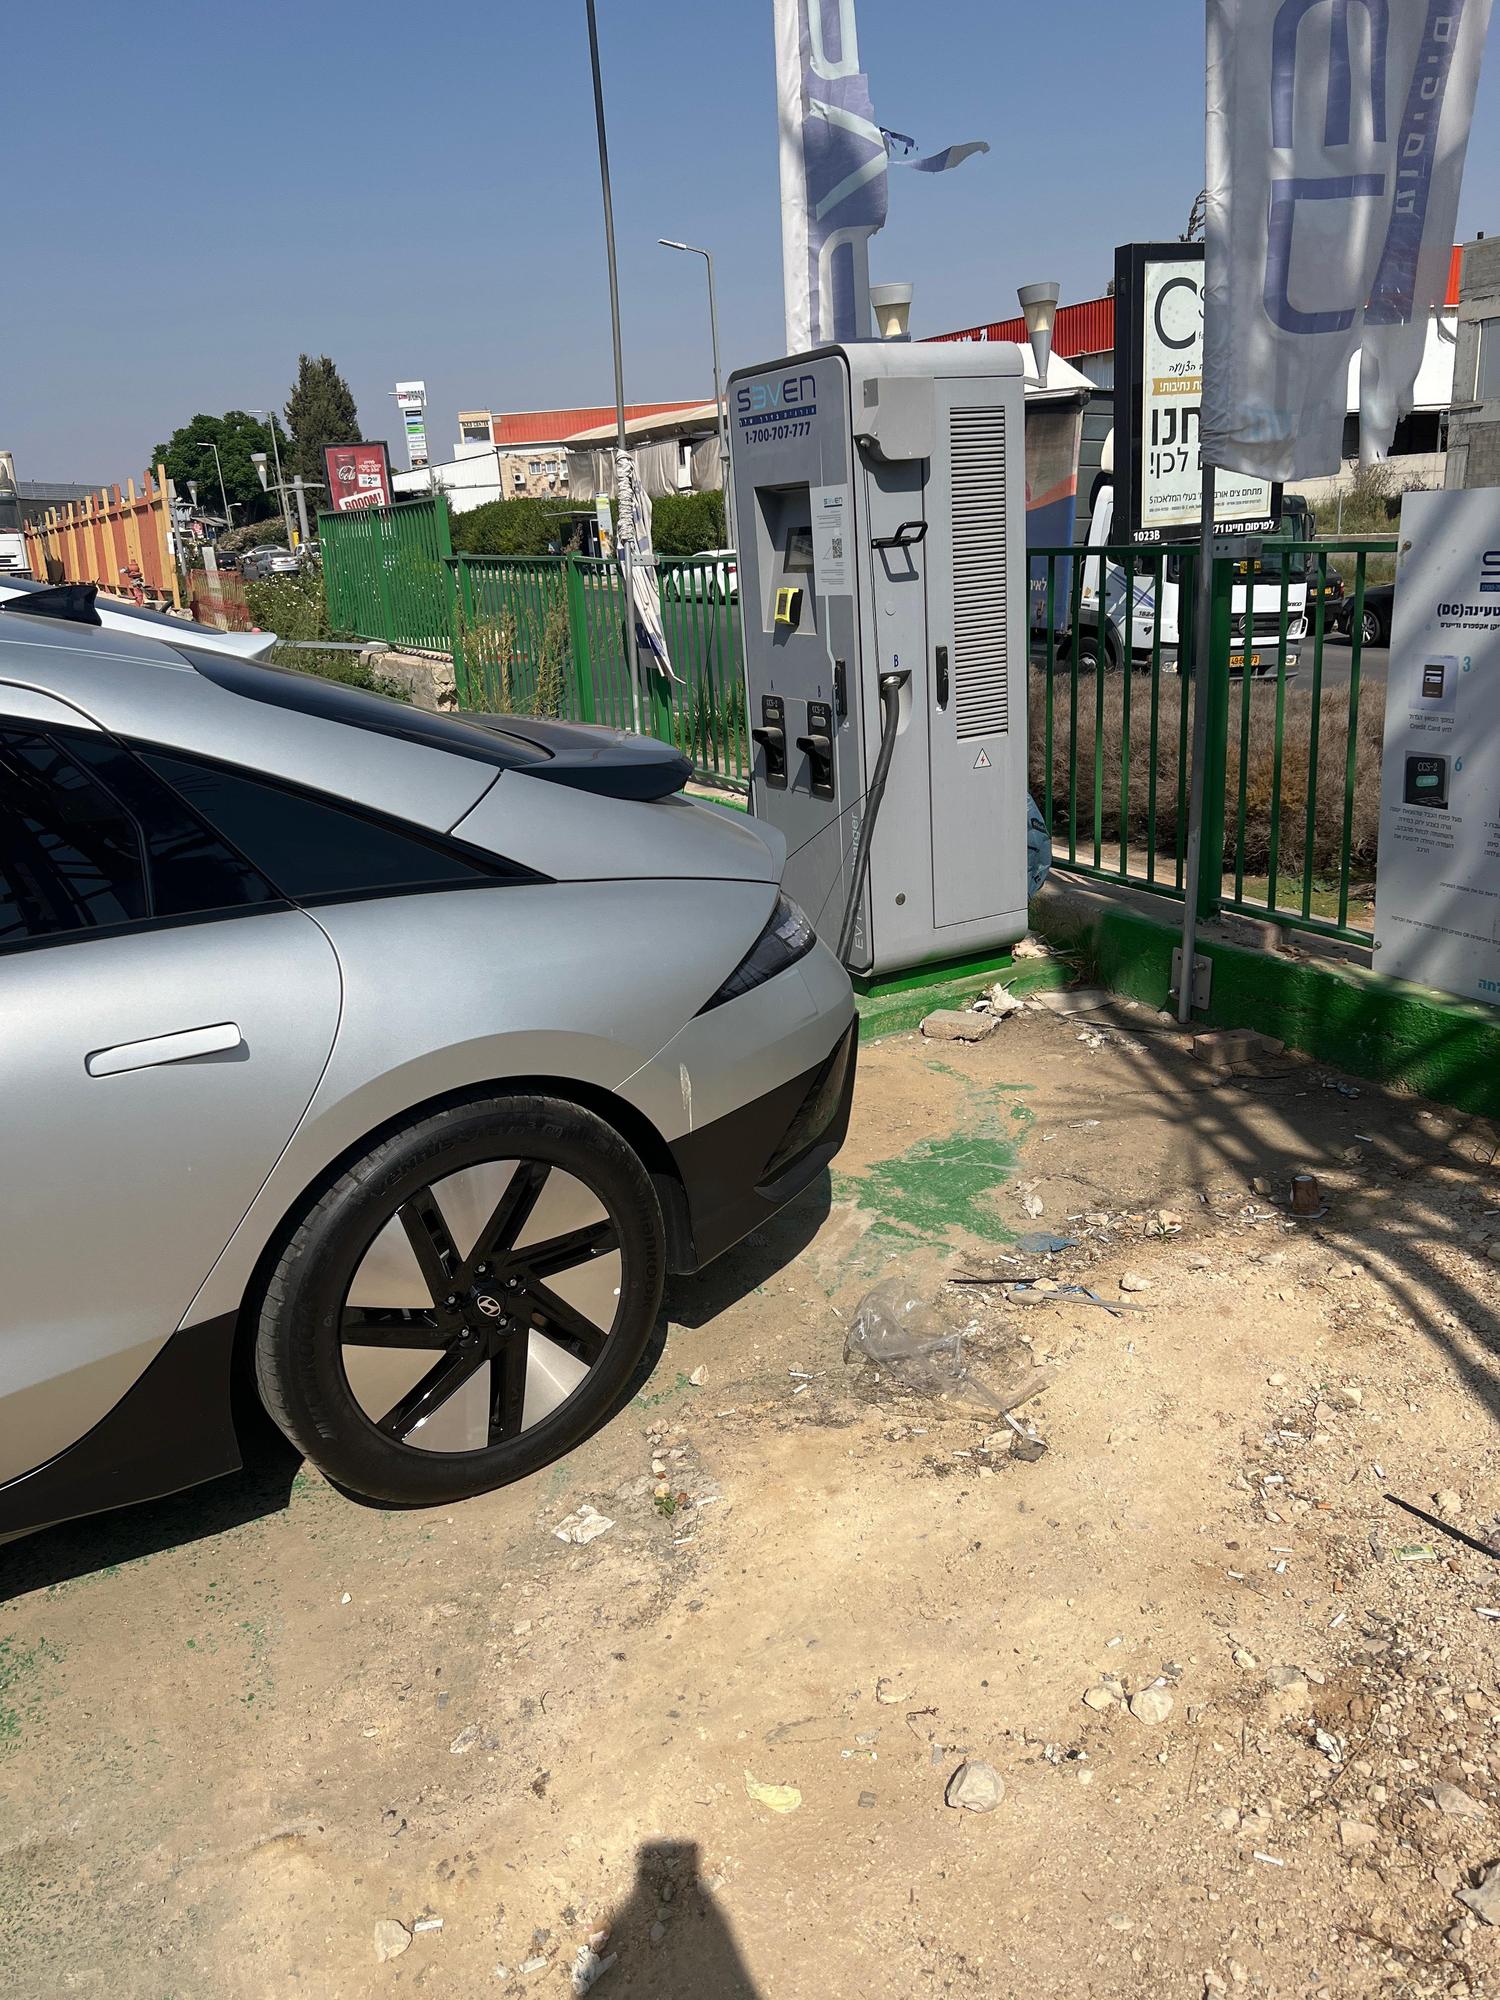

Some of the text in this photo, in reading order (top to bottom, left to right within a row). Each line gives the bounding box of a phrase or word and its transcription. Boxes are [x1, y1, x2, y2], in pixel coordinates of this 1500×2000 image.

[745, 421, 811, 445] 1-700-707-777
[1150, 446, 1189, 479] לכן!
[1213, 490, 1229, 499] אורב
[1244, 520, 1275, 531] לפרסום
[1133, 529, 1161, 542] 1023B
[893, 654, 900, 668] B
[1463, 656, 1471, 672] 3
[1455, 757, 1463, 772] 6
